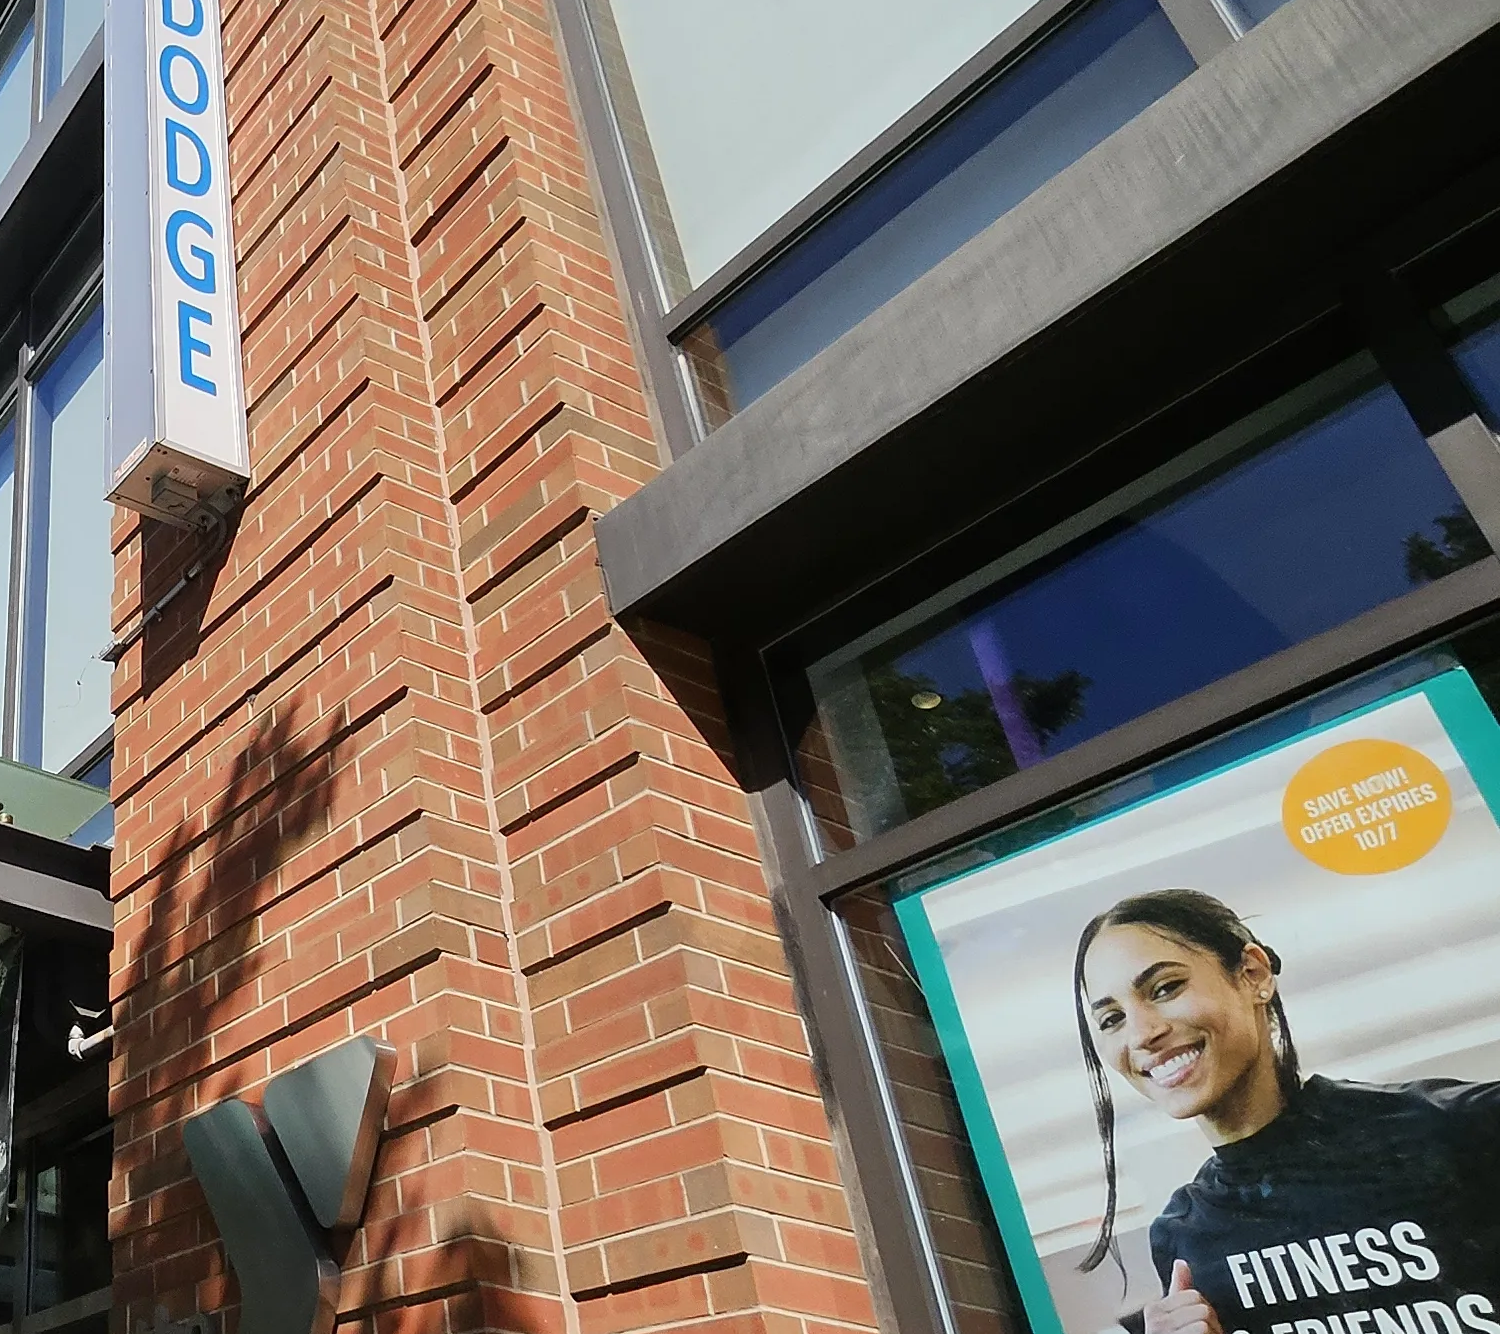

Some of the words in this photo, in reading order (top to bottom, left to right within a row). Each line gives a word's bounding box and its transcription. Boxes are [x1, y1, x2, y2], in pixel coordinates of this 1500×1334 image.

[1300, 812, 1356, 844] OFFER
[1355, 783, 1438, 826] EXPIRES
[1303, 787, 1354, 818] SAVE
[1351, 767, 1410, 801] NOW!
[1353, 822, 1398, 851] 10/7
[1226, 1219, 1441, 1310] FITNESS
